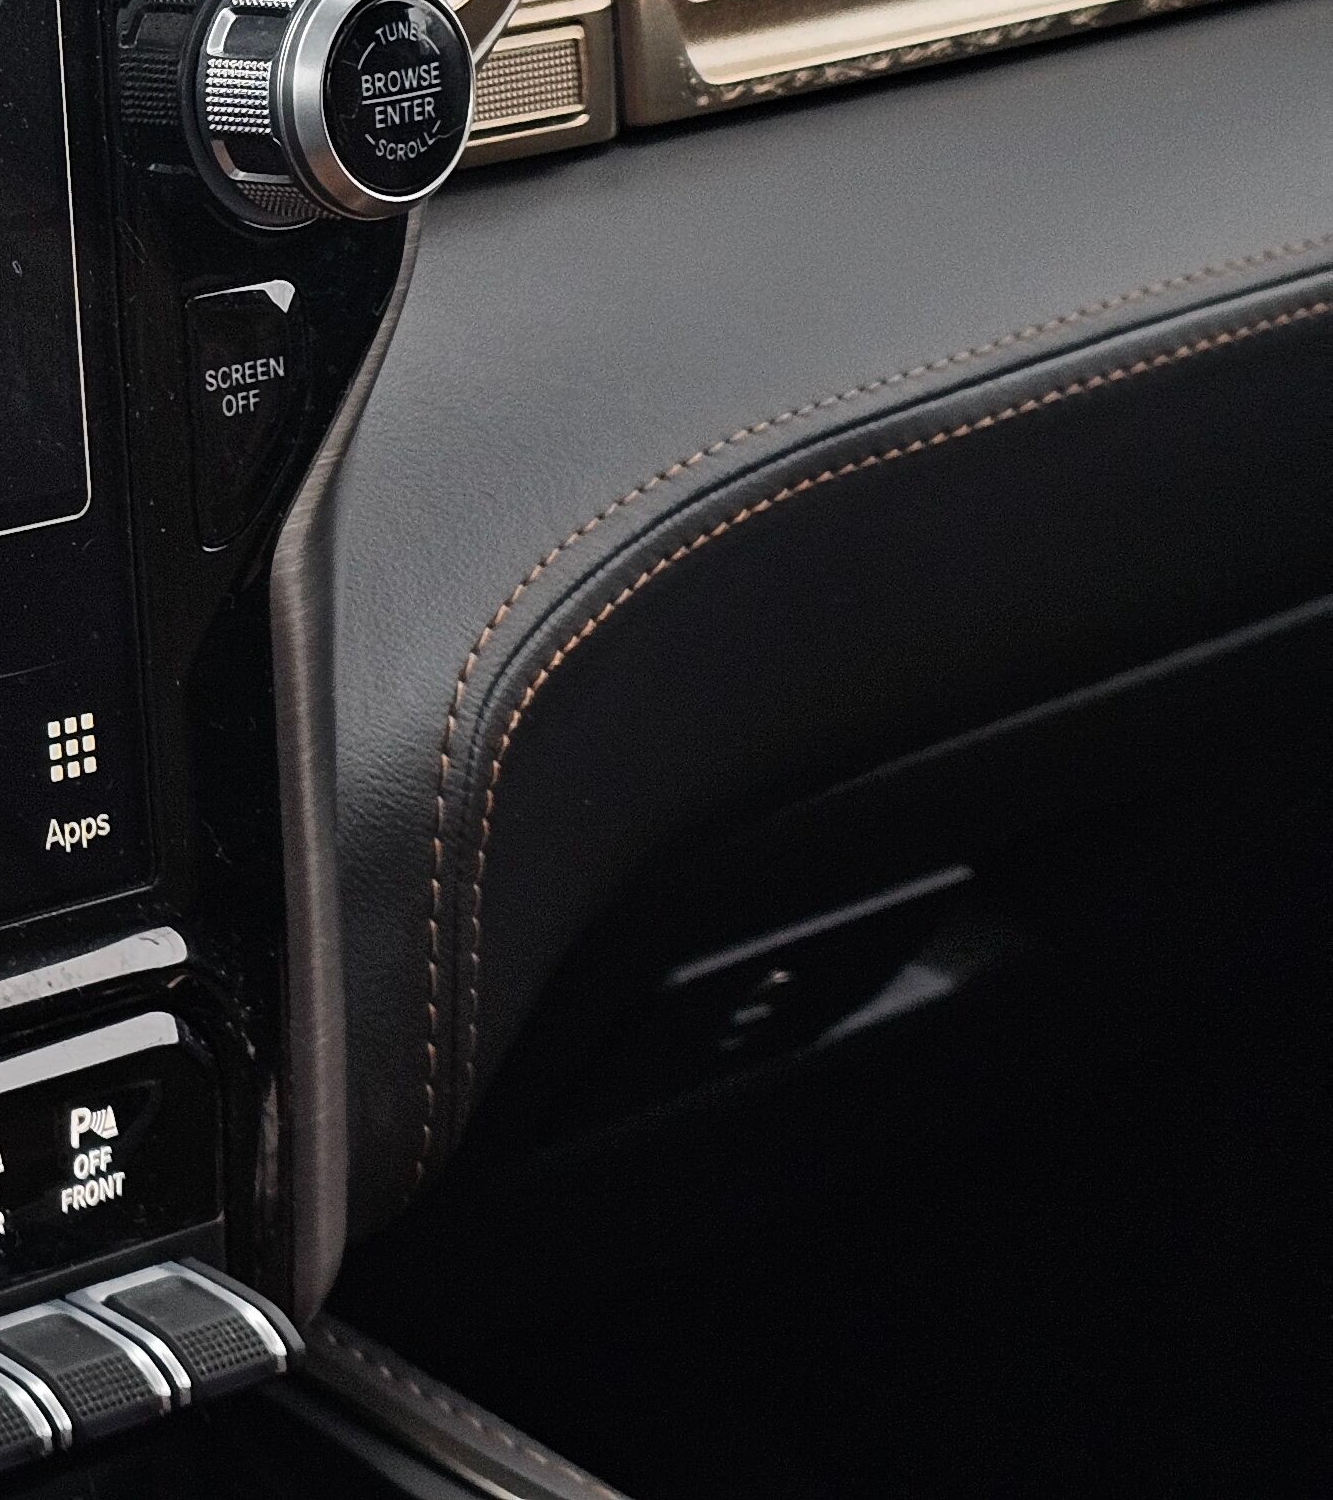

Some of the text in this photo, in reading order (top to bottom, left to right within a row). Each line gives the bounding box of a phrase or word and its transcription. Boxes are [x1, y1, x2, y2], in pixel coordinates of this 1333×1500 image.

[375, 21, 420, 47] TUNE
[361, 62, 441, 97] BROWSE
[374, 100, 436, 129] ENTER
[374, 131, 435, 161] SCROLL
[204, 355, 285, 392] SCREEN
[222, 389, 260, 417] OFF
[45, 813, 111, 853] Apps
[73, 1146, 113, 1180] OFF
[60, 1172, 126, 1214] FRONT
